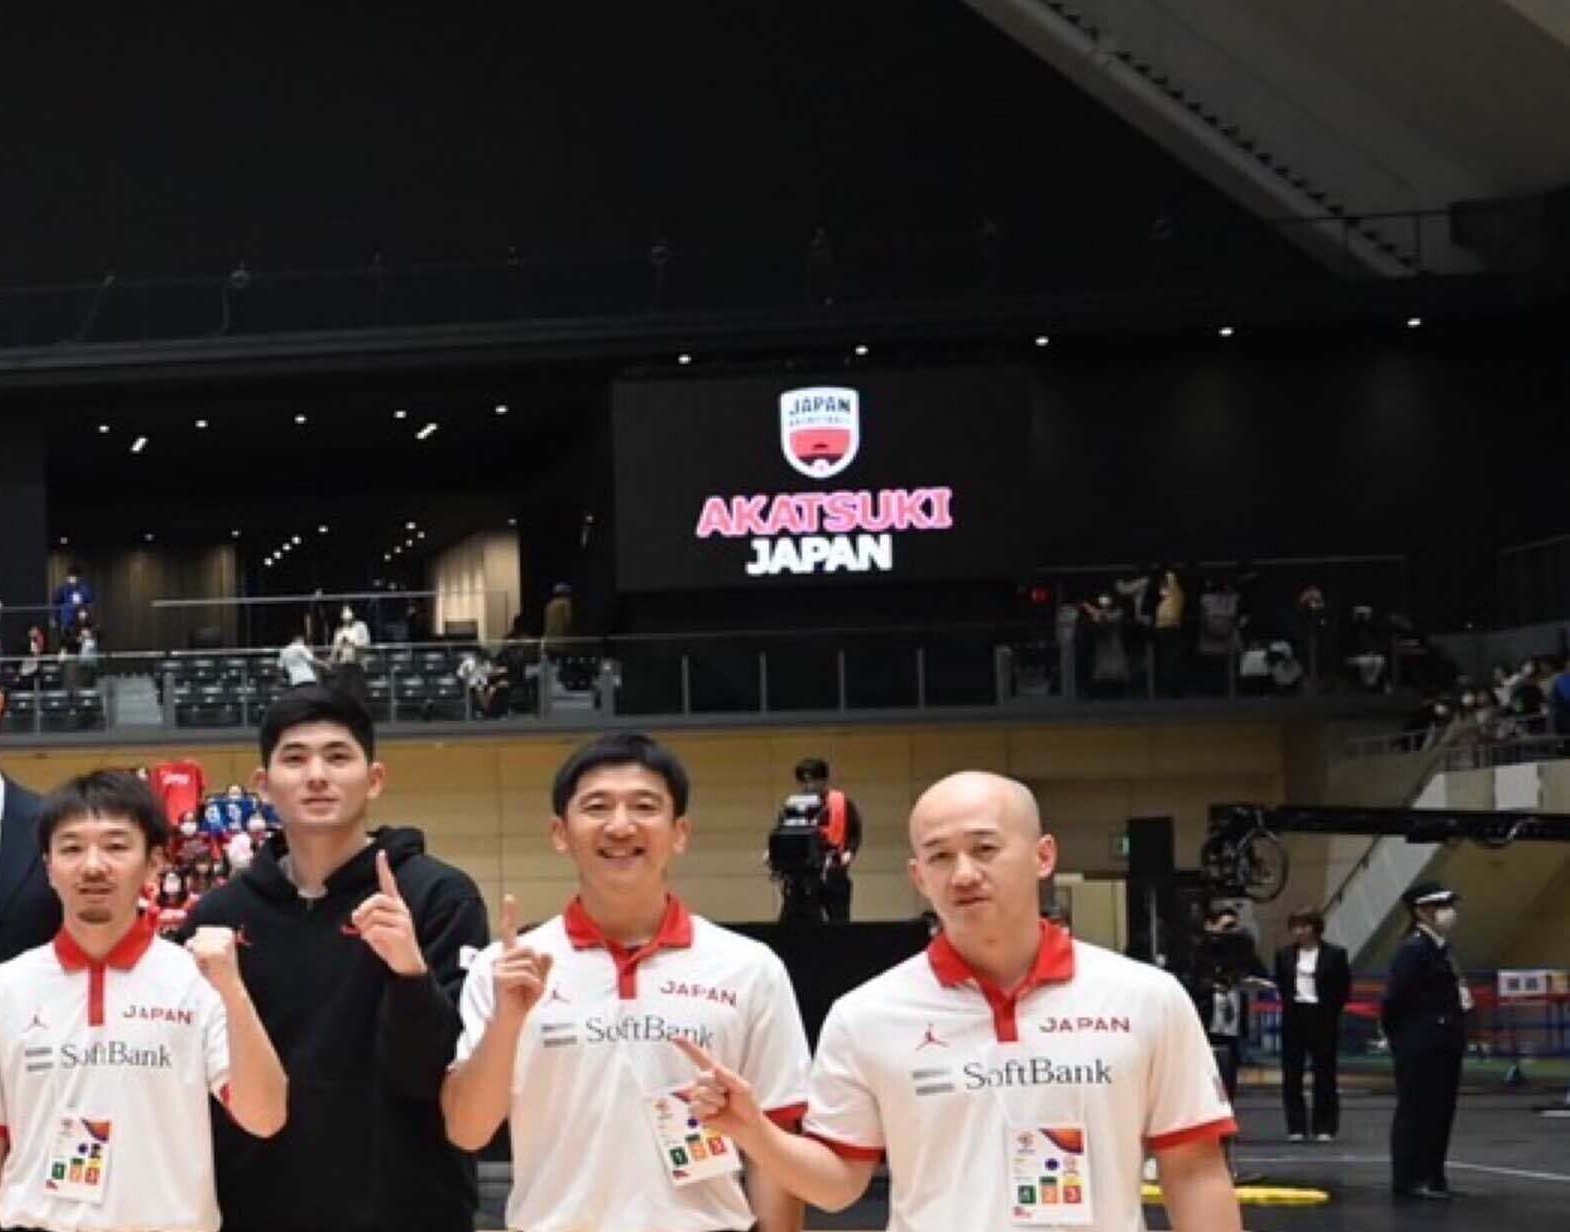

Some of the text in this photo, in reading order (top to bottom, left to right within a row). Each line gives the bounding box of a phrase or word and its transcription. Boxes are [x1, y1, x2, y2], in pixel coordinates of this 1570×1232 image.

[788, 396, 851, 415] JAPAN
[696, 486, 953, 538] AKATSUKI
[745, 534, 893, 576] JAPAN
[661, 980, 738, 1008] JAPAN
[123, 1004, 193, 1025] JAPAN
[1040, 1016, 1130, 1034] JAPAN
[585, 1015, 715, 1049] SoftBank
[60, 1041, 173, 1070] SoftBank
[962, 1056, 1113, 1091] SoftBank
